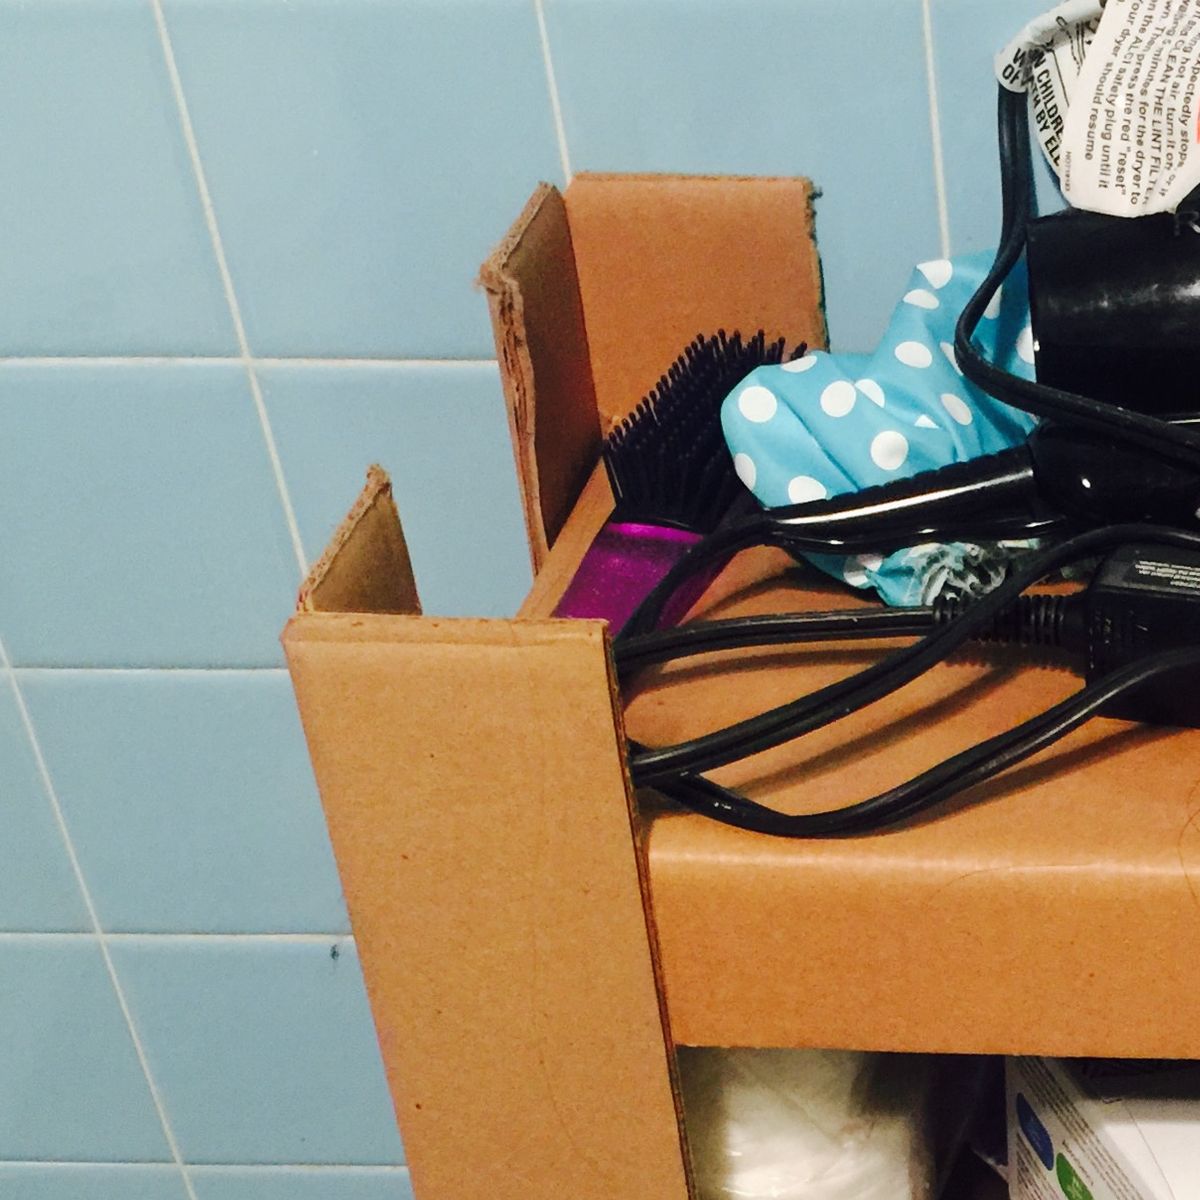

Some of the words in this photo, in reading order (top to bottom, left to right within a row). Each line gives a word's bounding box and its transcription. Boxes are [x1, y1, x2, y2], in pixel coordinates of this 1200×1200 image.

[1138, 15, 1152, 33] the
[1112, 29, 1129, 56] dryer
[1128, 54, 1144, 88] press
[1140, 48, 1162, 95] minutes
[1175, 56, 1190, 77] hot
[1093, 62, 1113, 104] should
[1105, 68, 1125, 105] safety
[1124, 93, 1133, 114] the
[1139, 102, 1148, 120] for
[1153, 87, 1164, 115] THE
[1085, 108, 1098, 160] resume
[1101, 109, 1116, 140] plug
[1120, 119, 1130, 141] red
[1166, 107, 1175, 135] turn
[1137, 125, 1145, 146] the
[1151, 120, 1160, 151] LINT
[1099, 145, 1110, 176] until
[1132, 150, 1144, 187] dryer
[1130, 192, 1140, 204] to
